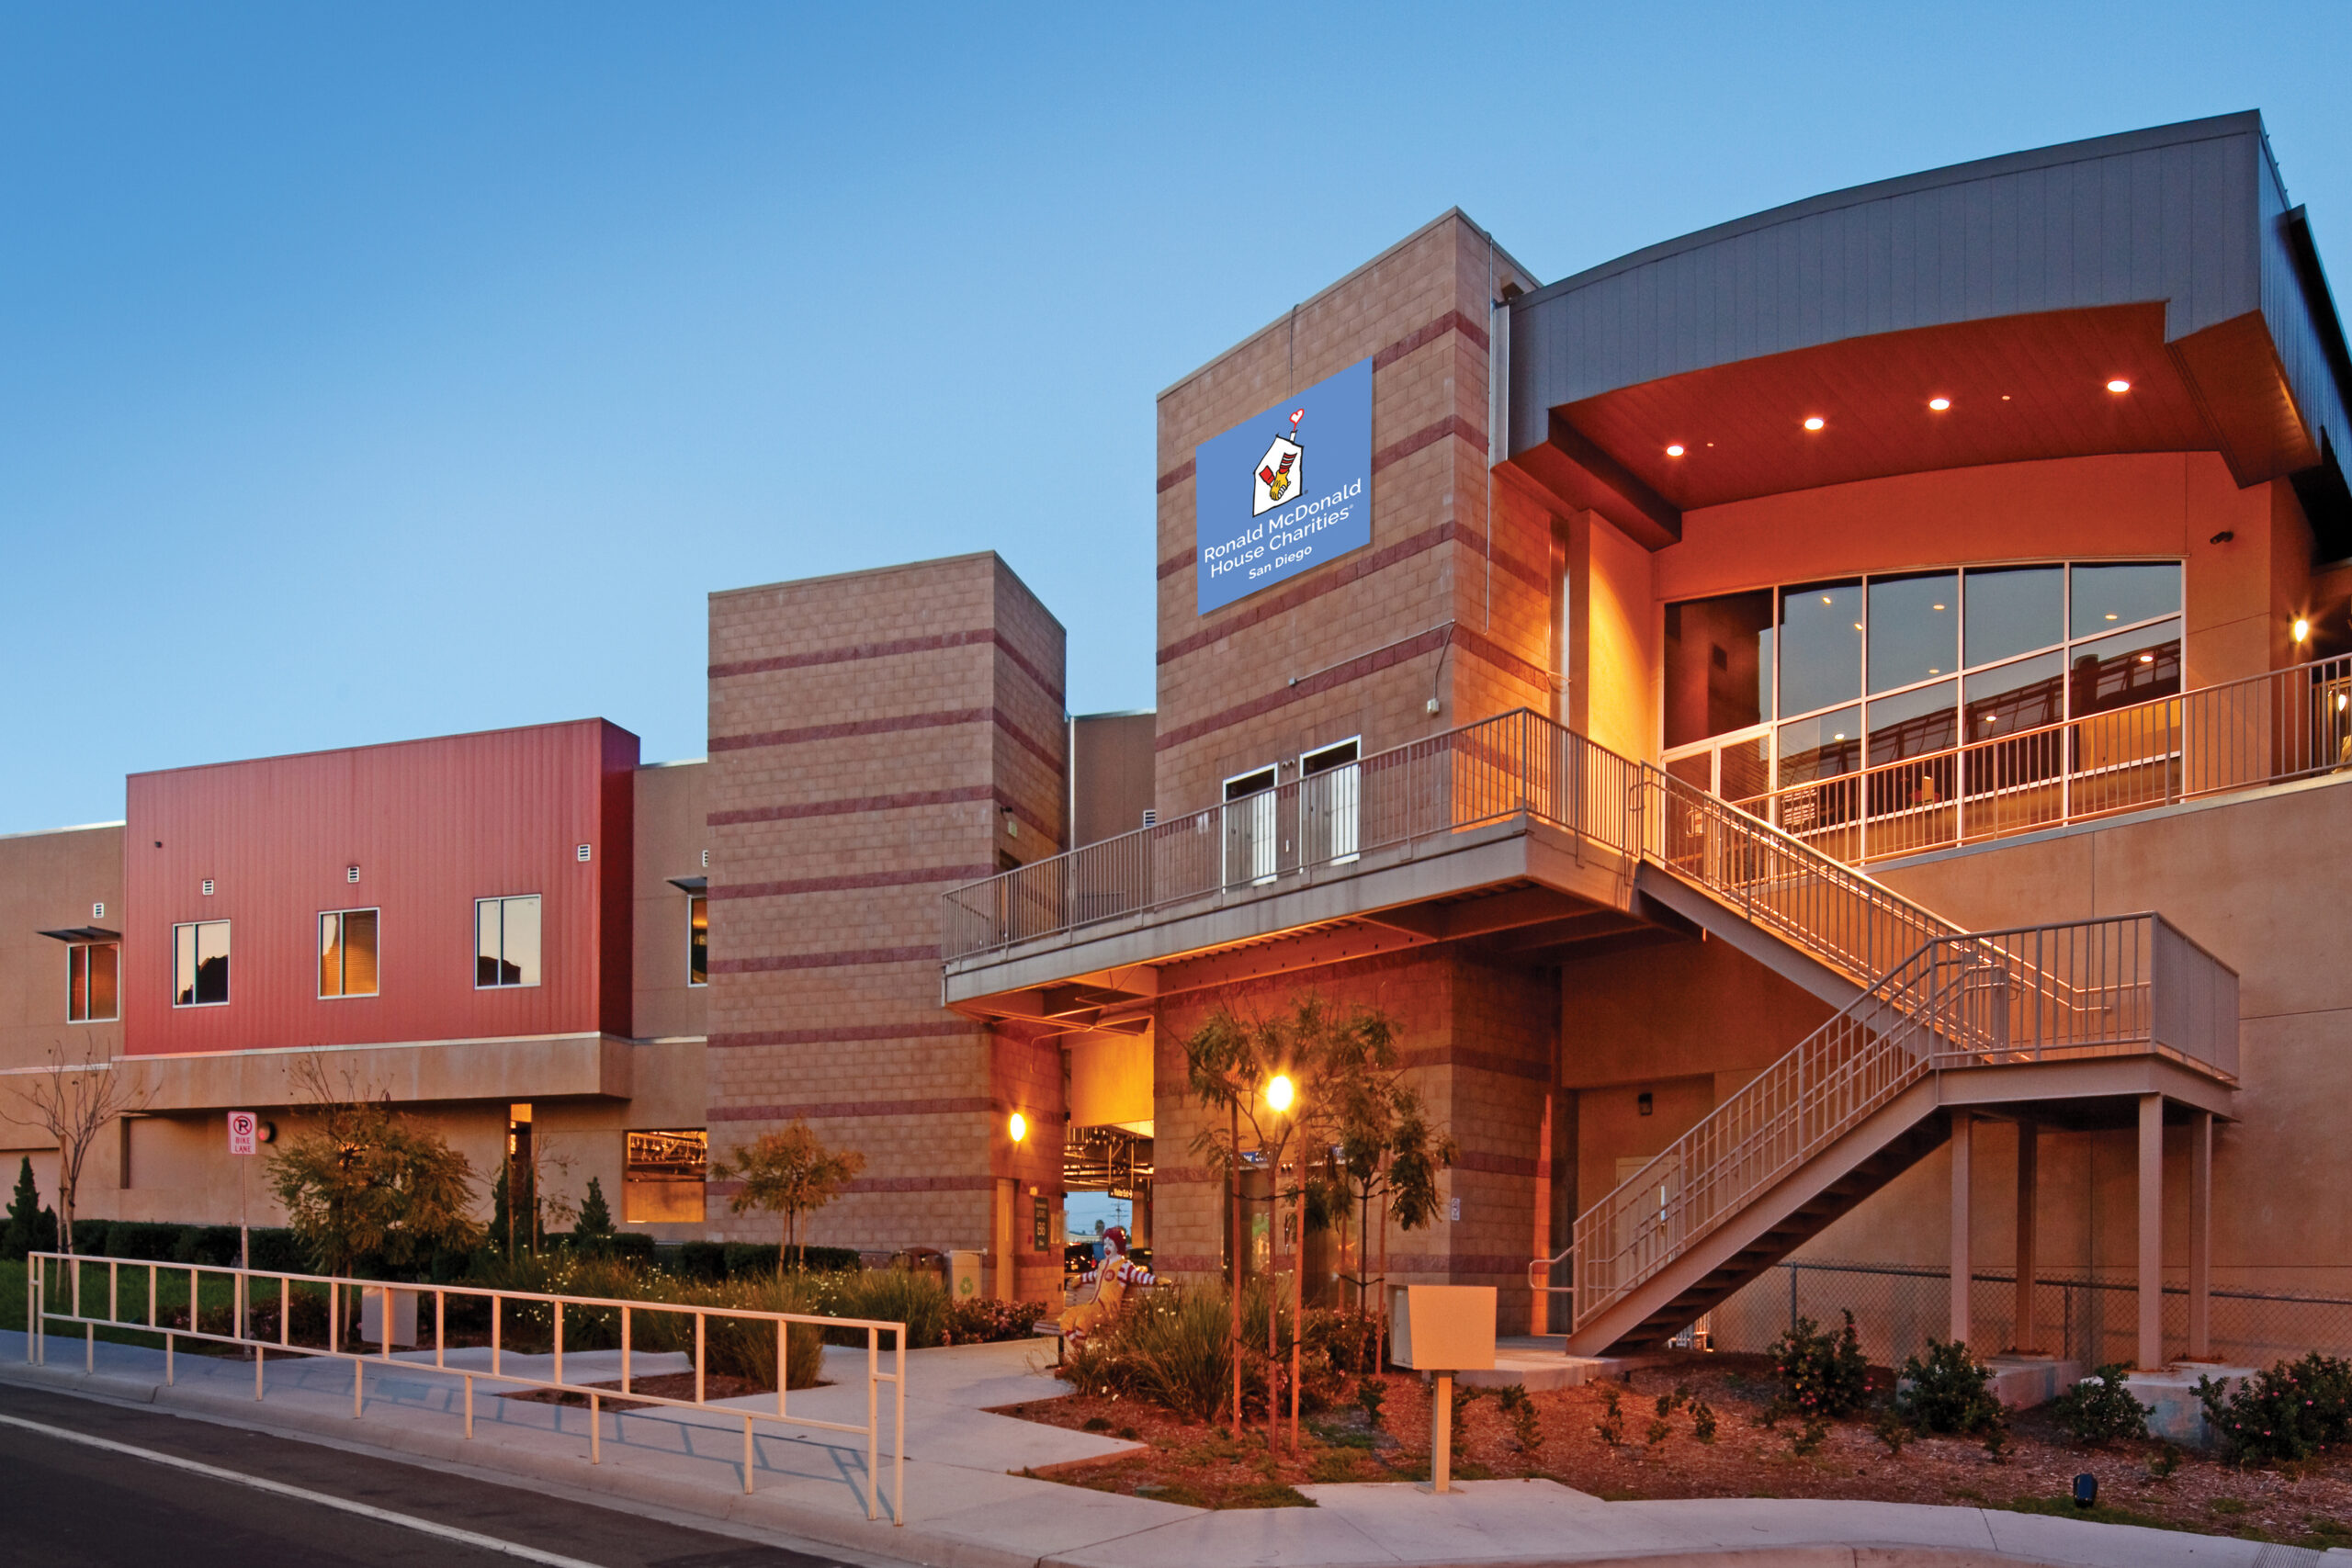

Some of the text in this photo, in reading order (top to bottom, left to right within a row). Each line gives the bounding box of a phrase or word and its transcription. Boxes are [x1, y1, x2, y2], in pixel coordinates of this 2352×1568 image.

[1204, 478, 1362, 563] Ronald McDonald
[1211, 507, 1350, 578] House Charities
[1249, 546, 1312, 580] San Diego
